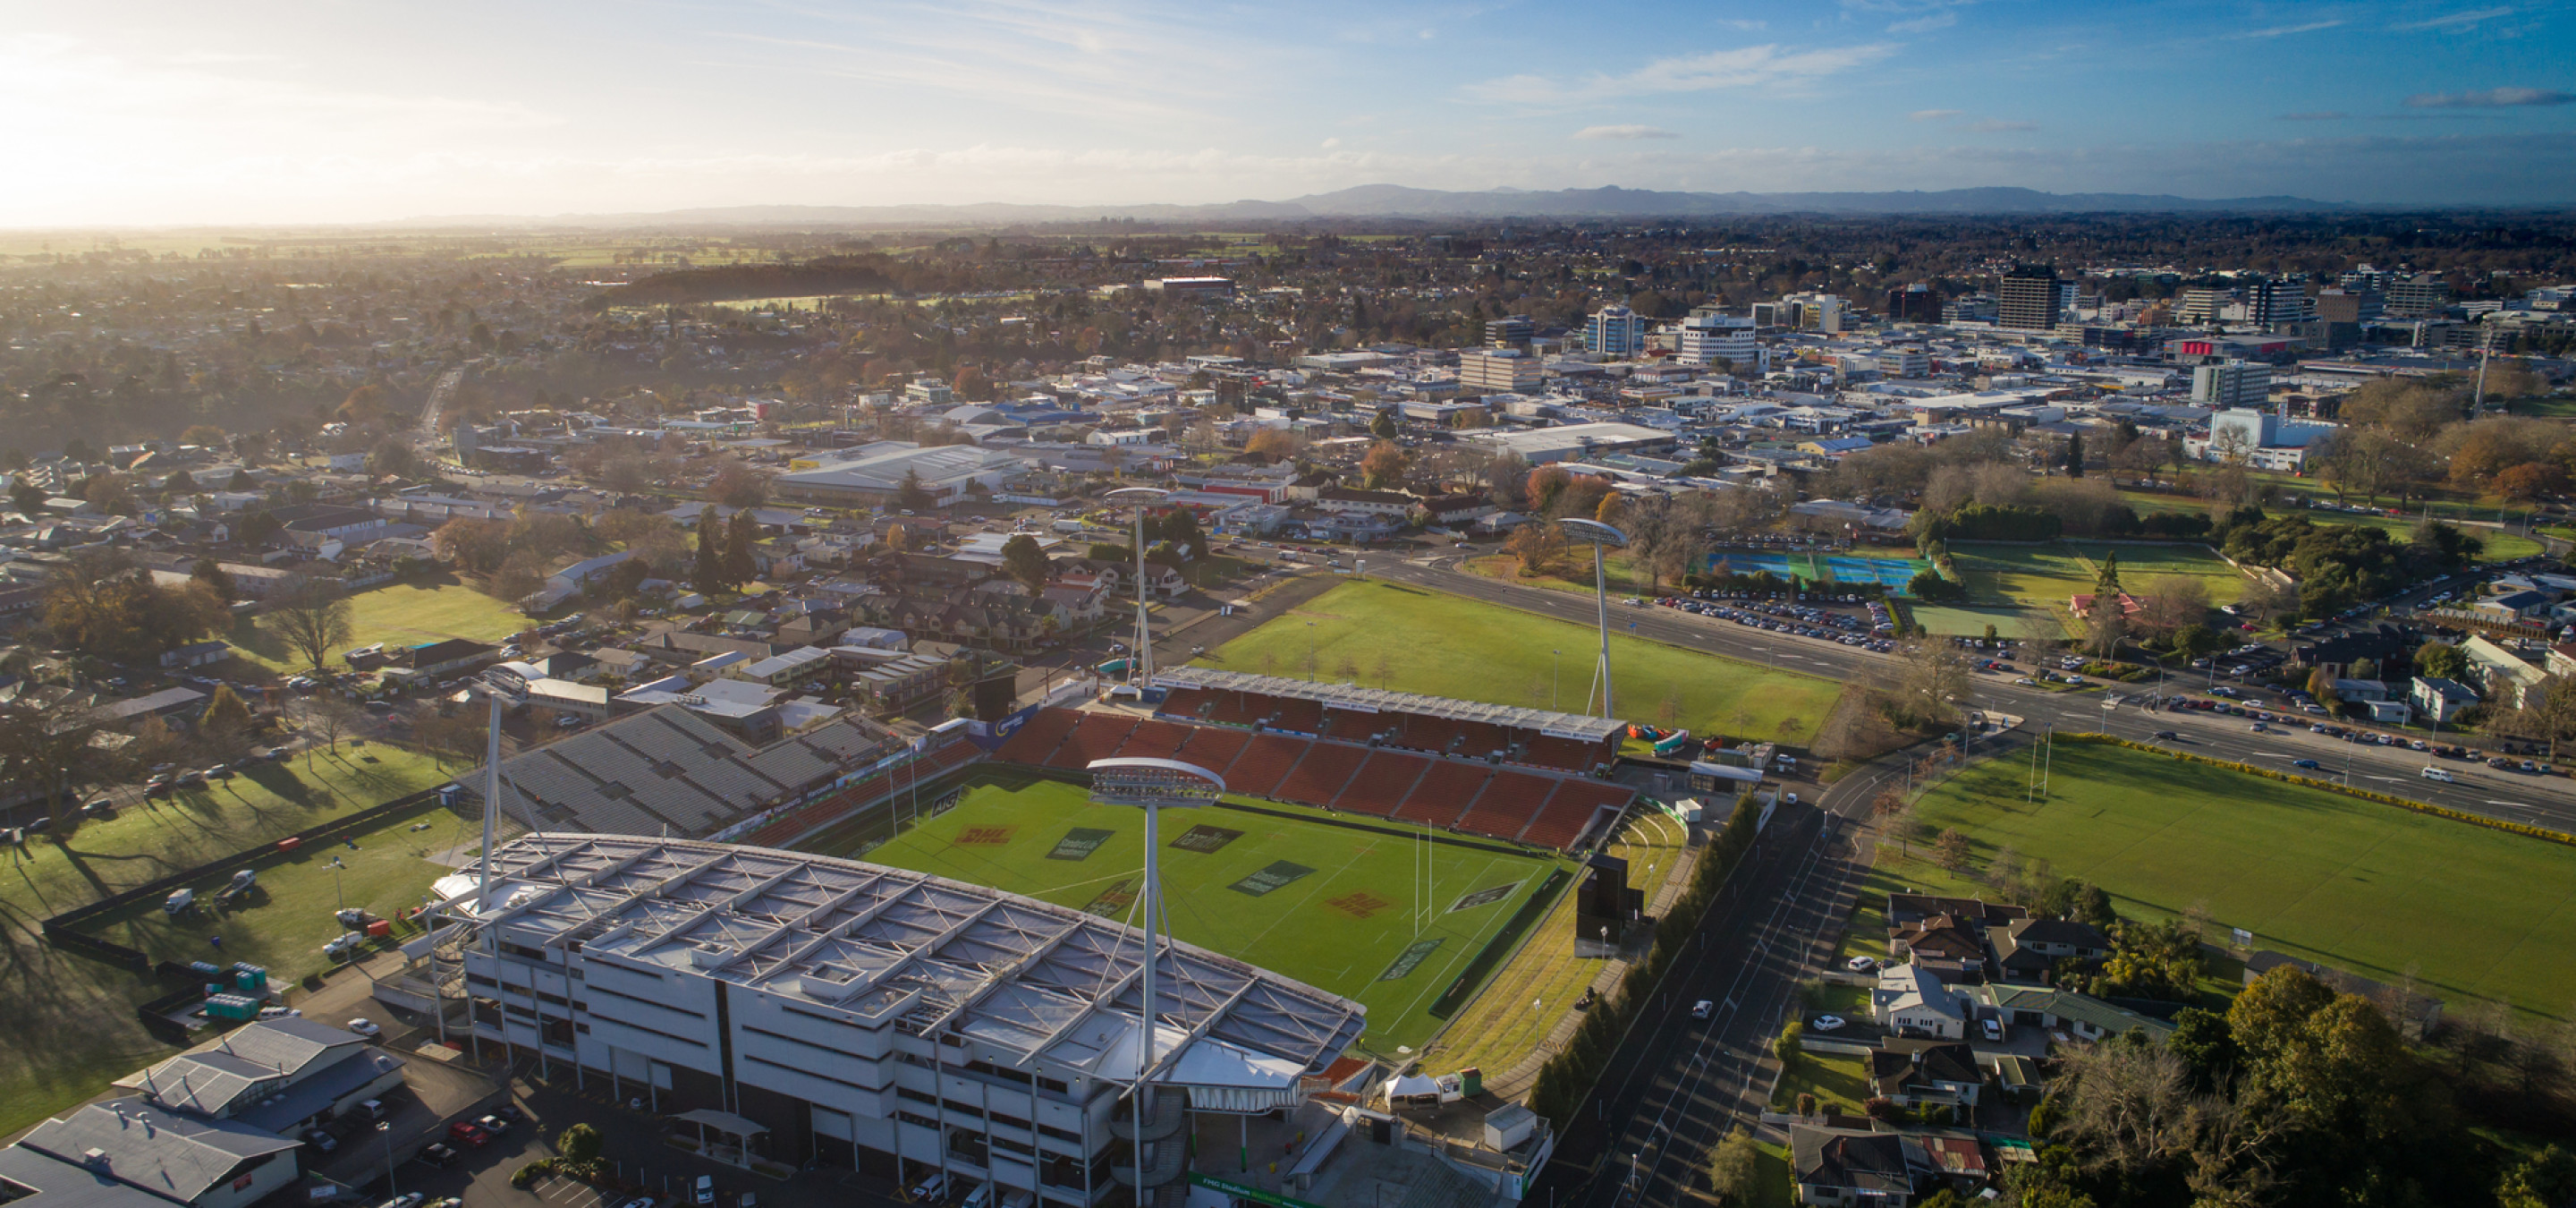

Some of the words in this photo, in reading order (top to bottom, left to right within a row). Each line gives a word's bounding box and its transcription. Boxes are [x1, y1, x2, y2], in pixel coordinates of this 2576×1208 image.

[934, 794, 959, 814] AIG
[961, 828, 1012, 844] DHL
[1222, 1183, 1250, 1195] Stadium
